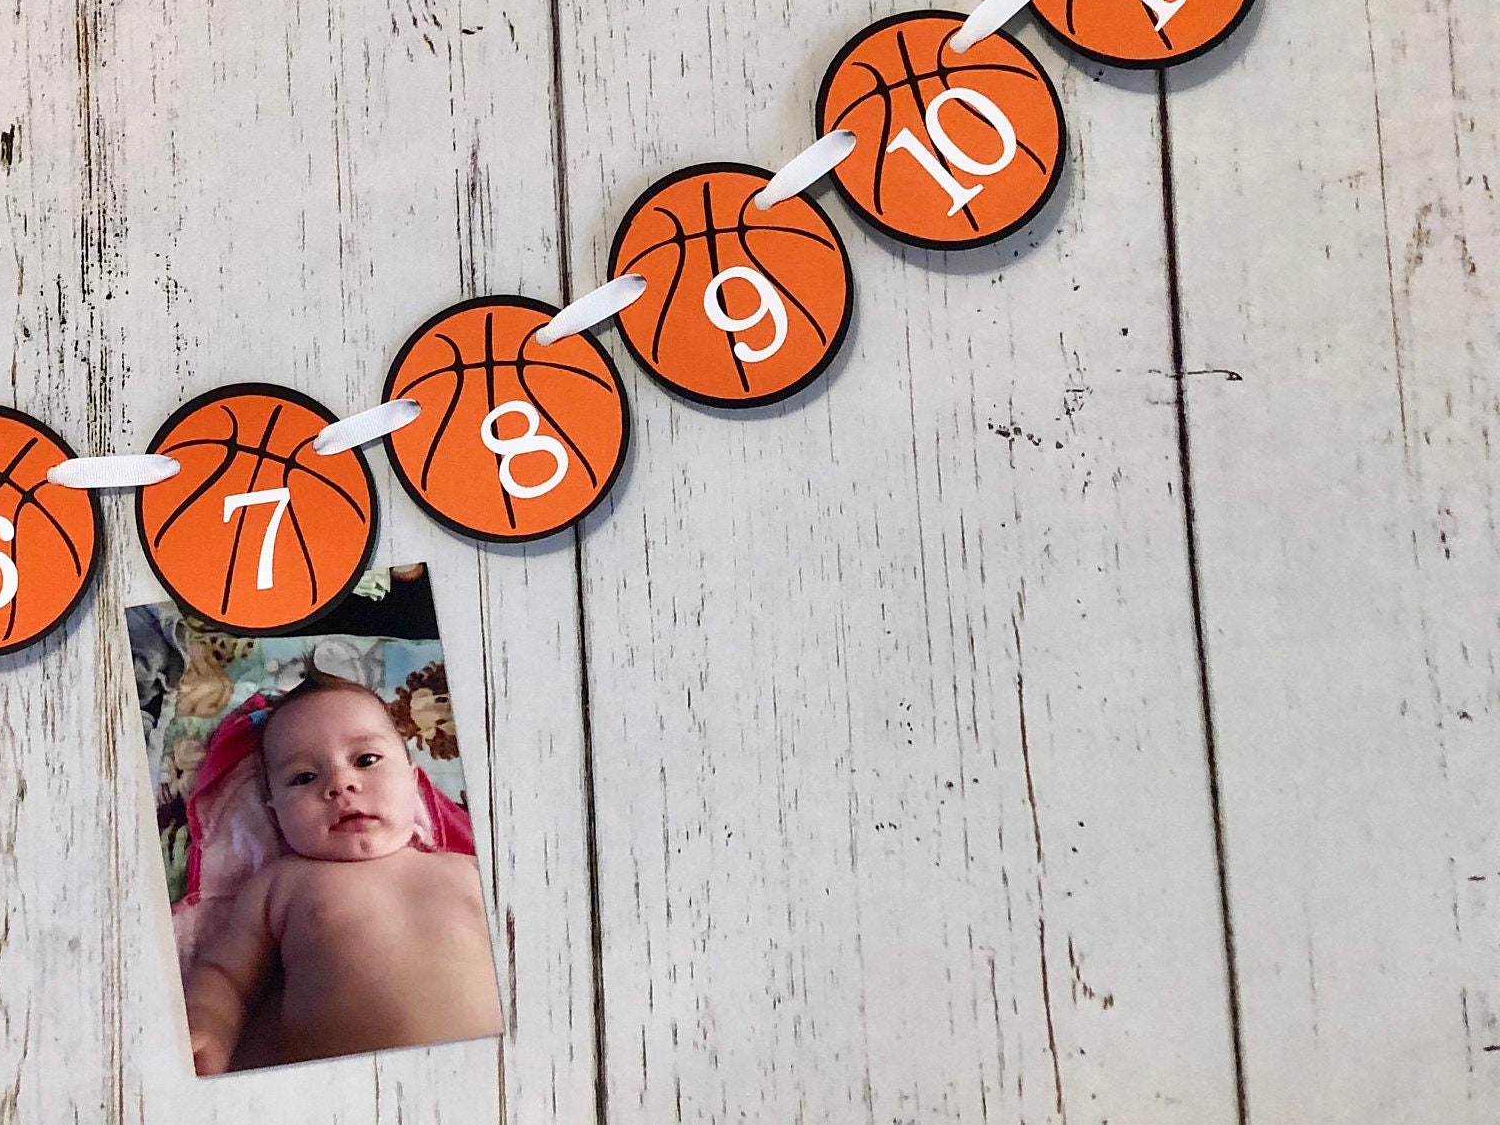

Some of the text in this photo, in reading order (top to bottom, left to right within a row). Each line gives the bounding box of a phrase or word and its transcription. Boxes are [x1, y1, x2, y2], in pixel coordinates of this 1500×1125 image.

[886, 88, 1017, 216] 10
[703, 266, 788, 363] 9
[480, 400, 569, 499] 8
[223, 487, 291, 590] 7
